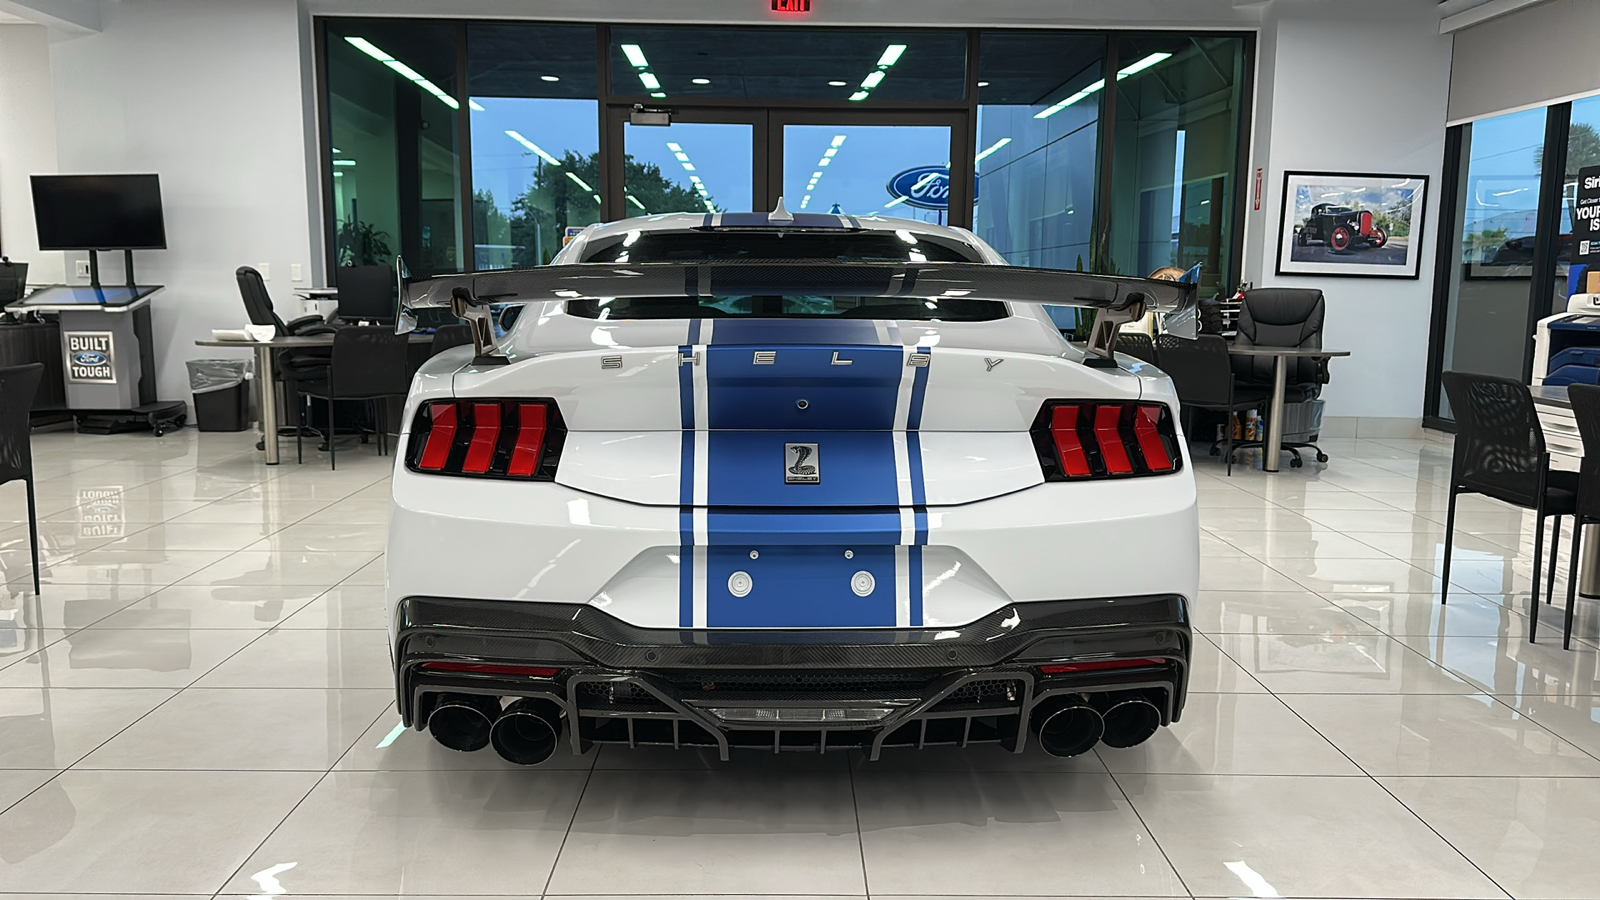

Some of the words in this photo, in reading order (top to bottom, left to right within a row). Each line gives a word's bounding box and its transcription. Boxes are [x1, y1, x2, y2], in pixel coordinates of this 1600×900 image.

[911, 173, 949, 198] For
[1584, 175, 1600, 189] Sir
[70, 337, 108, 350] BUILT
[80, 353, 100, 363] Ford
[601, 350, 1004, 372] SHELBY
[72, 366, 111, 378] TOUGH
